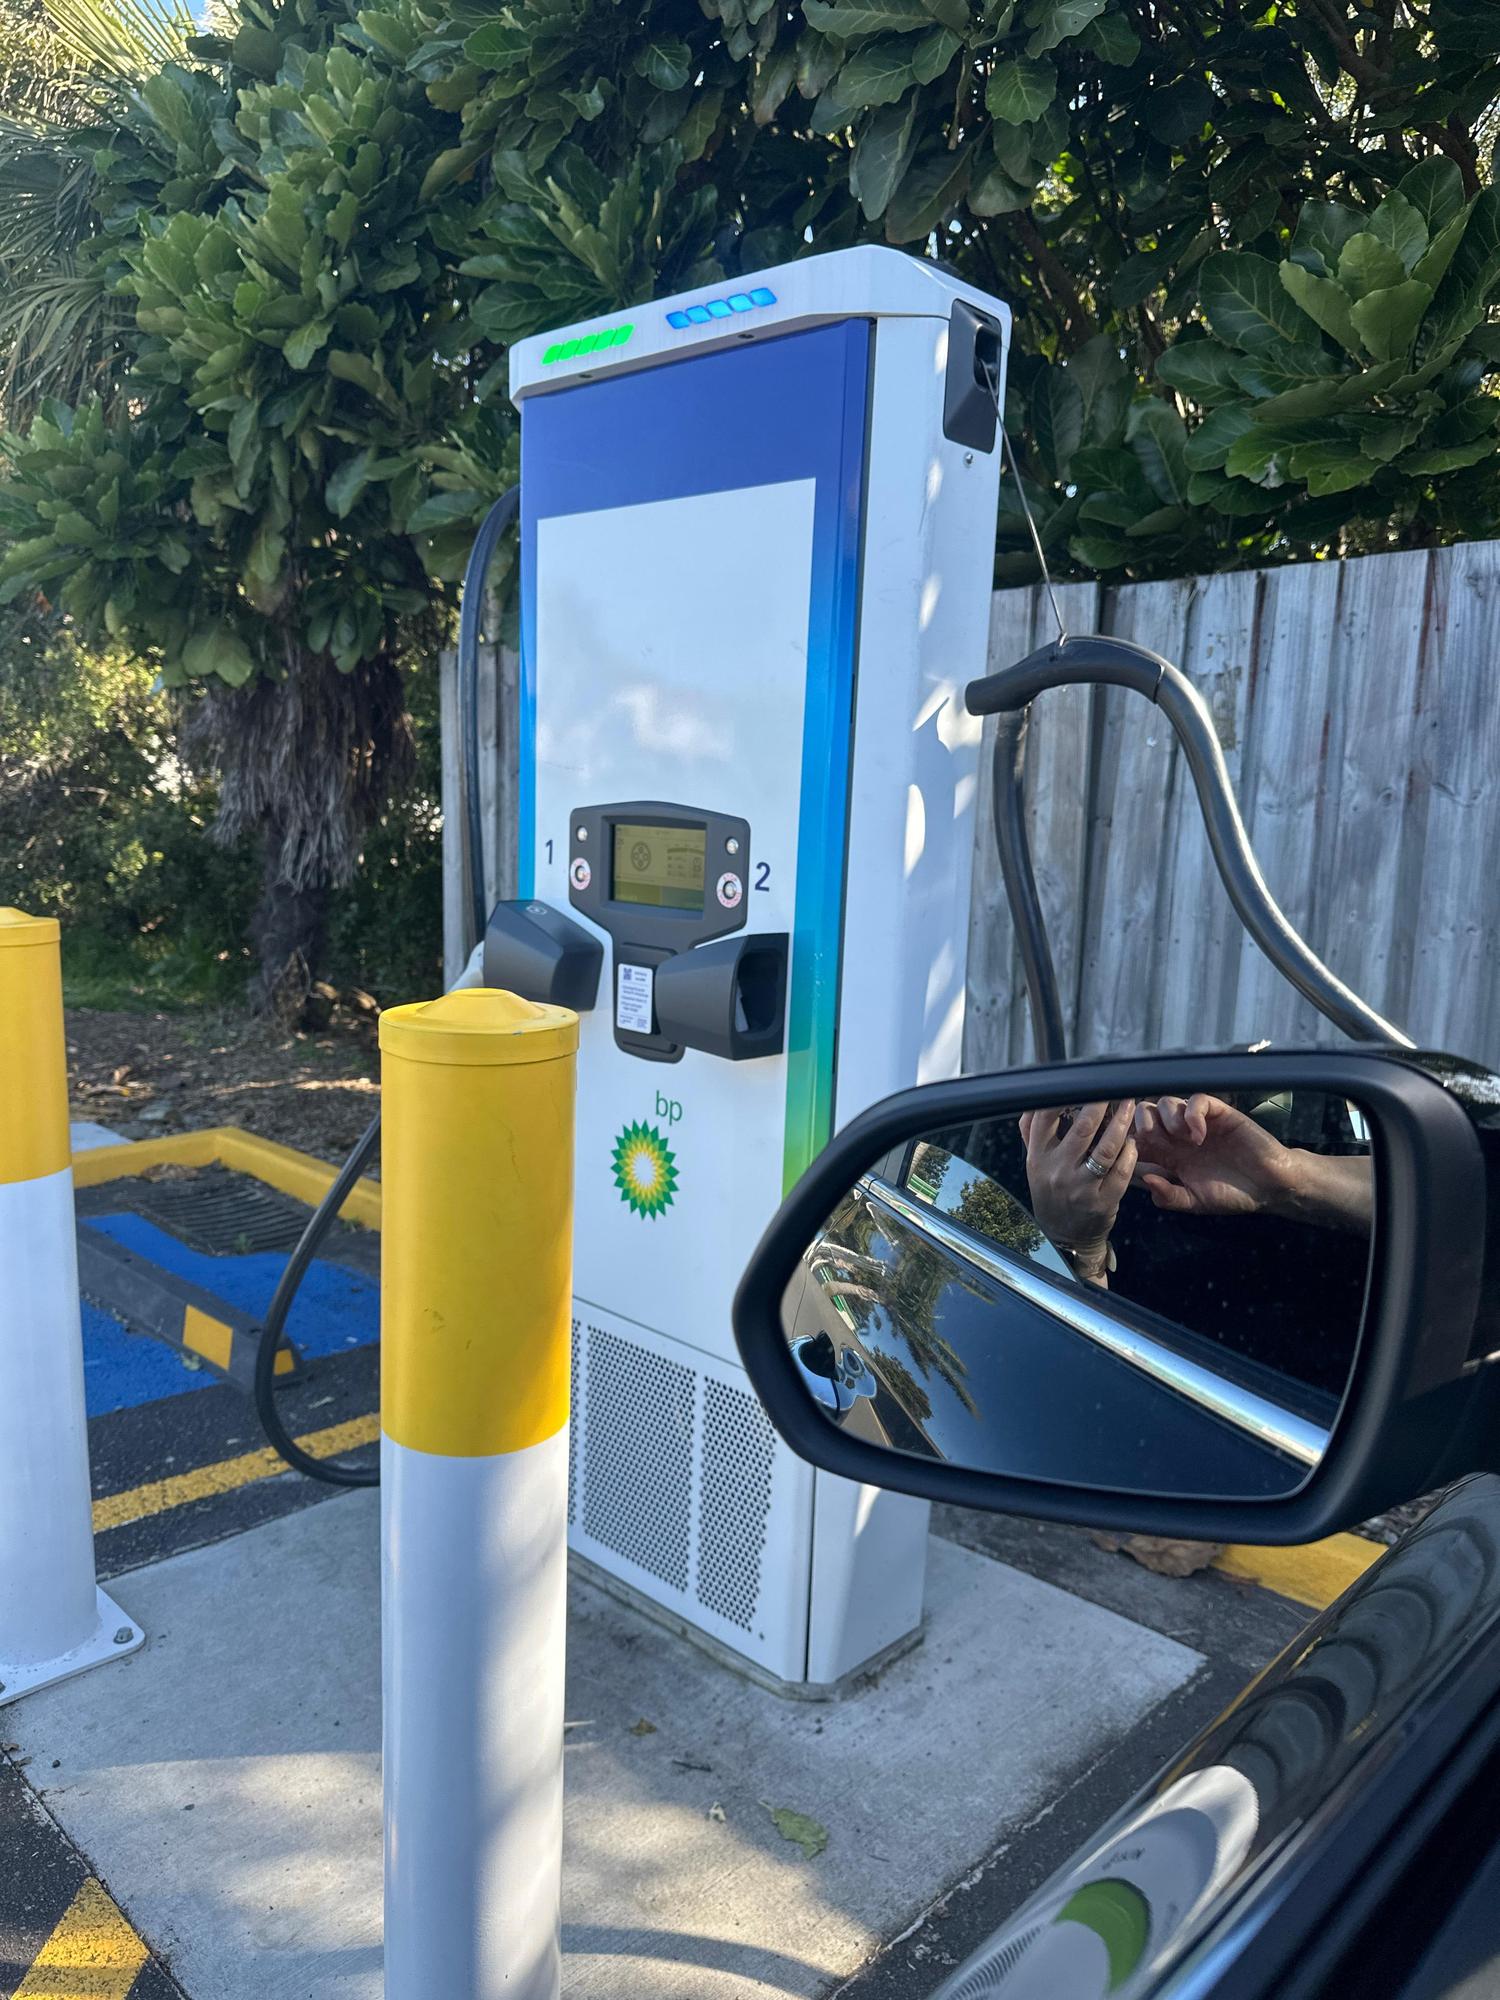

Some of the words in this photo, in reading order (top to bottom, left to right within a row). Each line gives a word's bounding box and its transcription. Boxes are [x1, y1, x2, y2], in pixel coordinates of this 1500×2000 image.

[545, 839, 553, 865] 1
[755, 861, 771, 892] 2
[656, 1089, 683, 1126] bp
